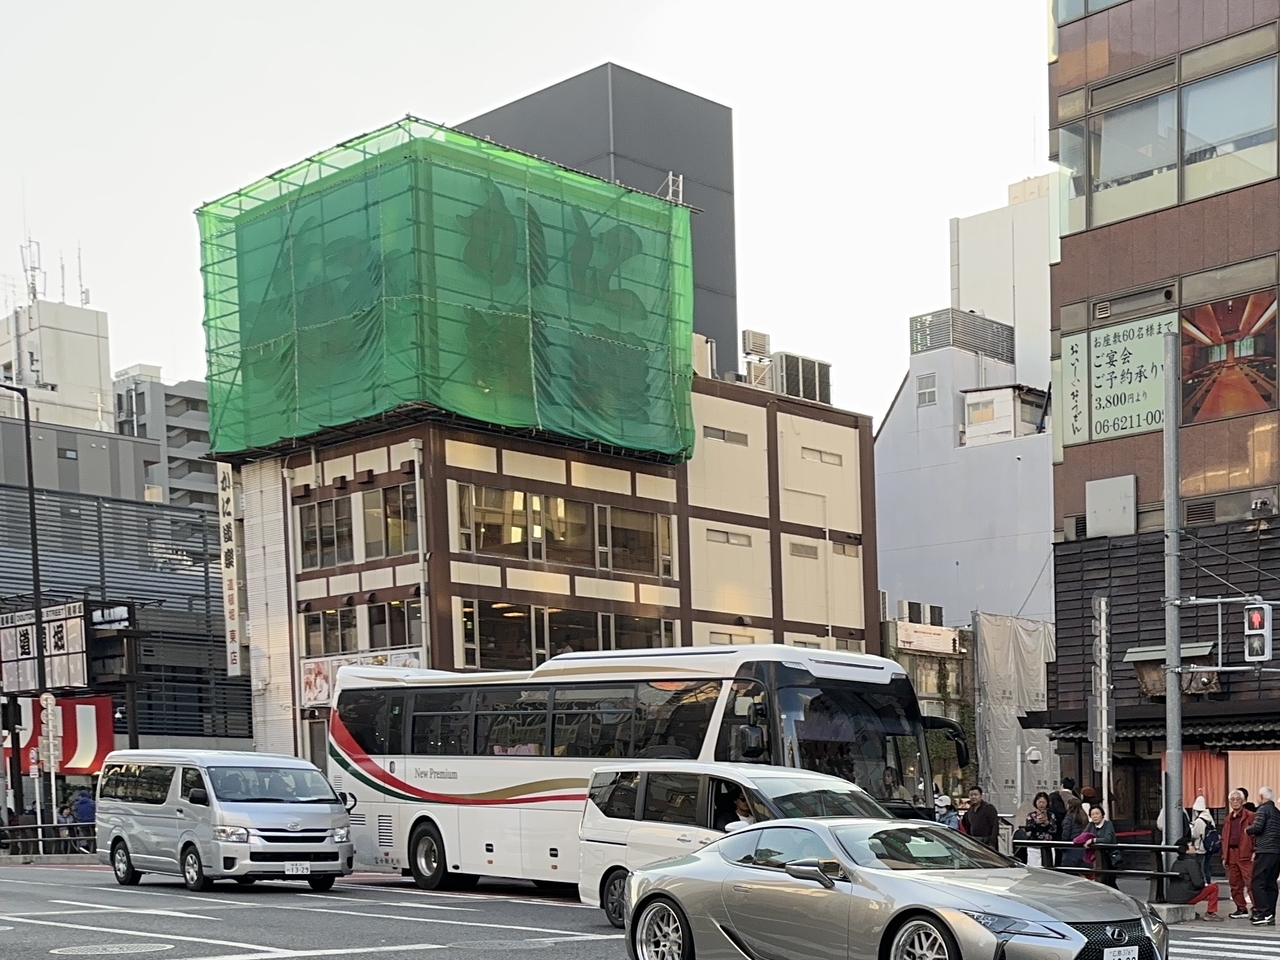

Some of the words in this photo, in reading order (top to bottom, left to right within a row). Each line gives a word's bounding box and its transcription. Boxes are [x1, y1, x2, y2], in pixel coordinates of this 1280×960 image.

[1094, 347, 1133, 368] ご宴会
[1094, 362, 1164, 389] ご予約承り
[414, 768, 428, 779] New
[429, 768, 458, 780] Premium
